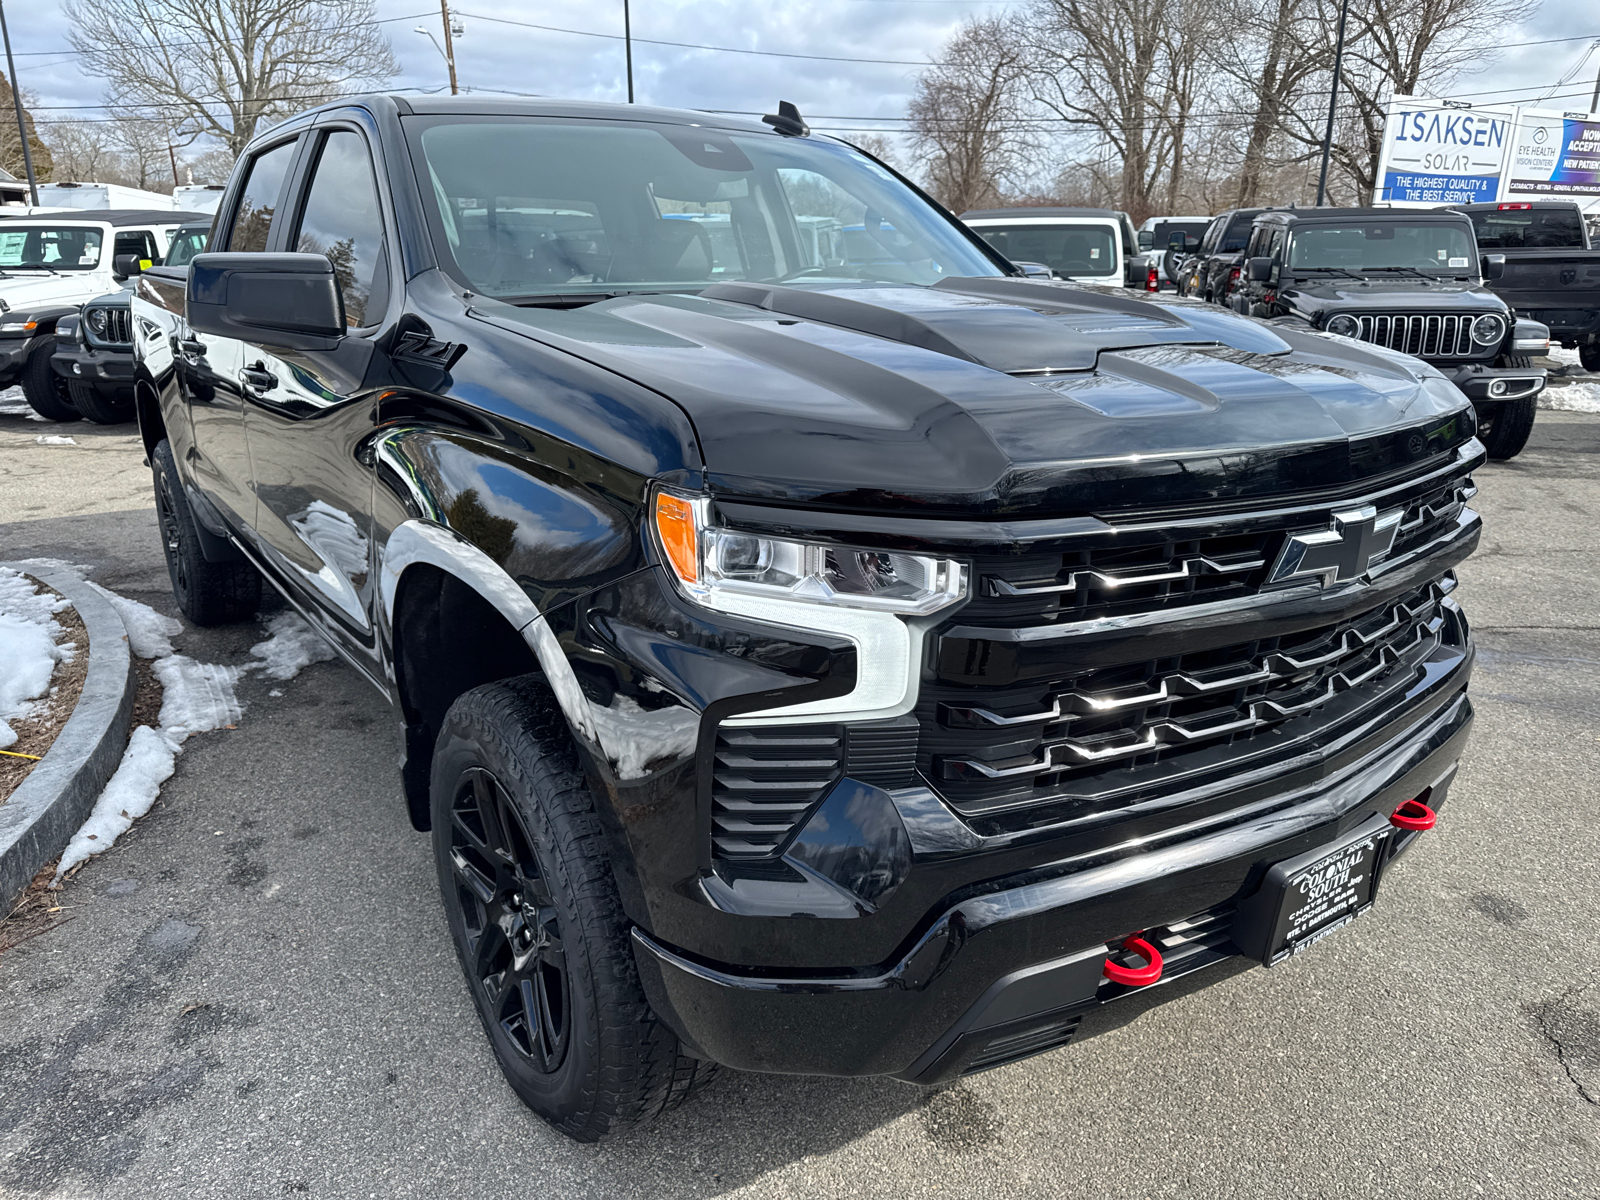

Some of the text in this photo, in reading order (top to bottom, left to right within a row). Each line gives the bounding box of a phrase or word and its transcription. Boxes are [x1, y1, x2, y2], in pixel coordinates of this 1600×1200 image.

[1396, 112, 1506, 147] ISAKSEN
[1518, 146, 1556, 156] EYE HEALTH
[1424, 153, 1469, 171] SOLAR
[1517, 157, 1553, 167] VISION CENTERS
[1563, 159, 1578, 168] NEW
[1396, 176, 1487, 190] THE HIGHEST QUALITY &
[1405, 189, 1476, 202] THE BEST SERVICE
[1300, 850, 1363, 893] COLONIAL
[1307, 868, 1350, 903] SOUTH
[1289, 887, 1342, 920] CHRYSLER
[1293, 902, 1328, 926] DODGE
